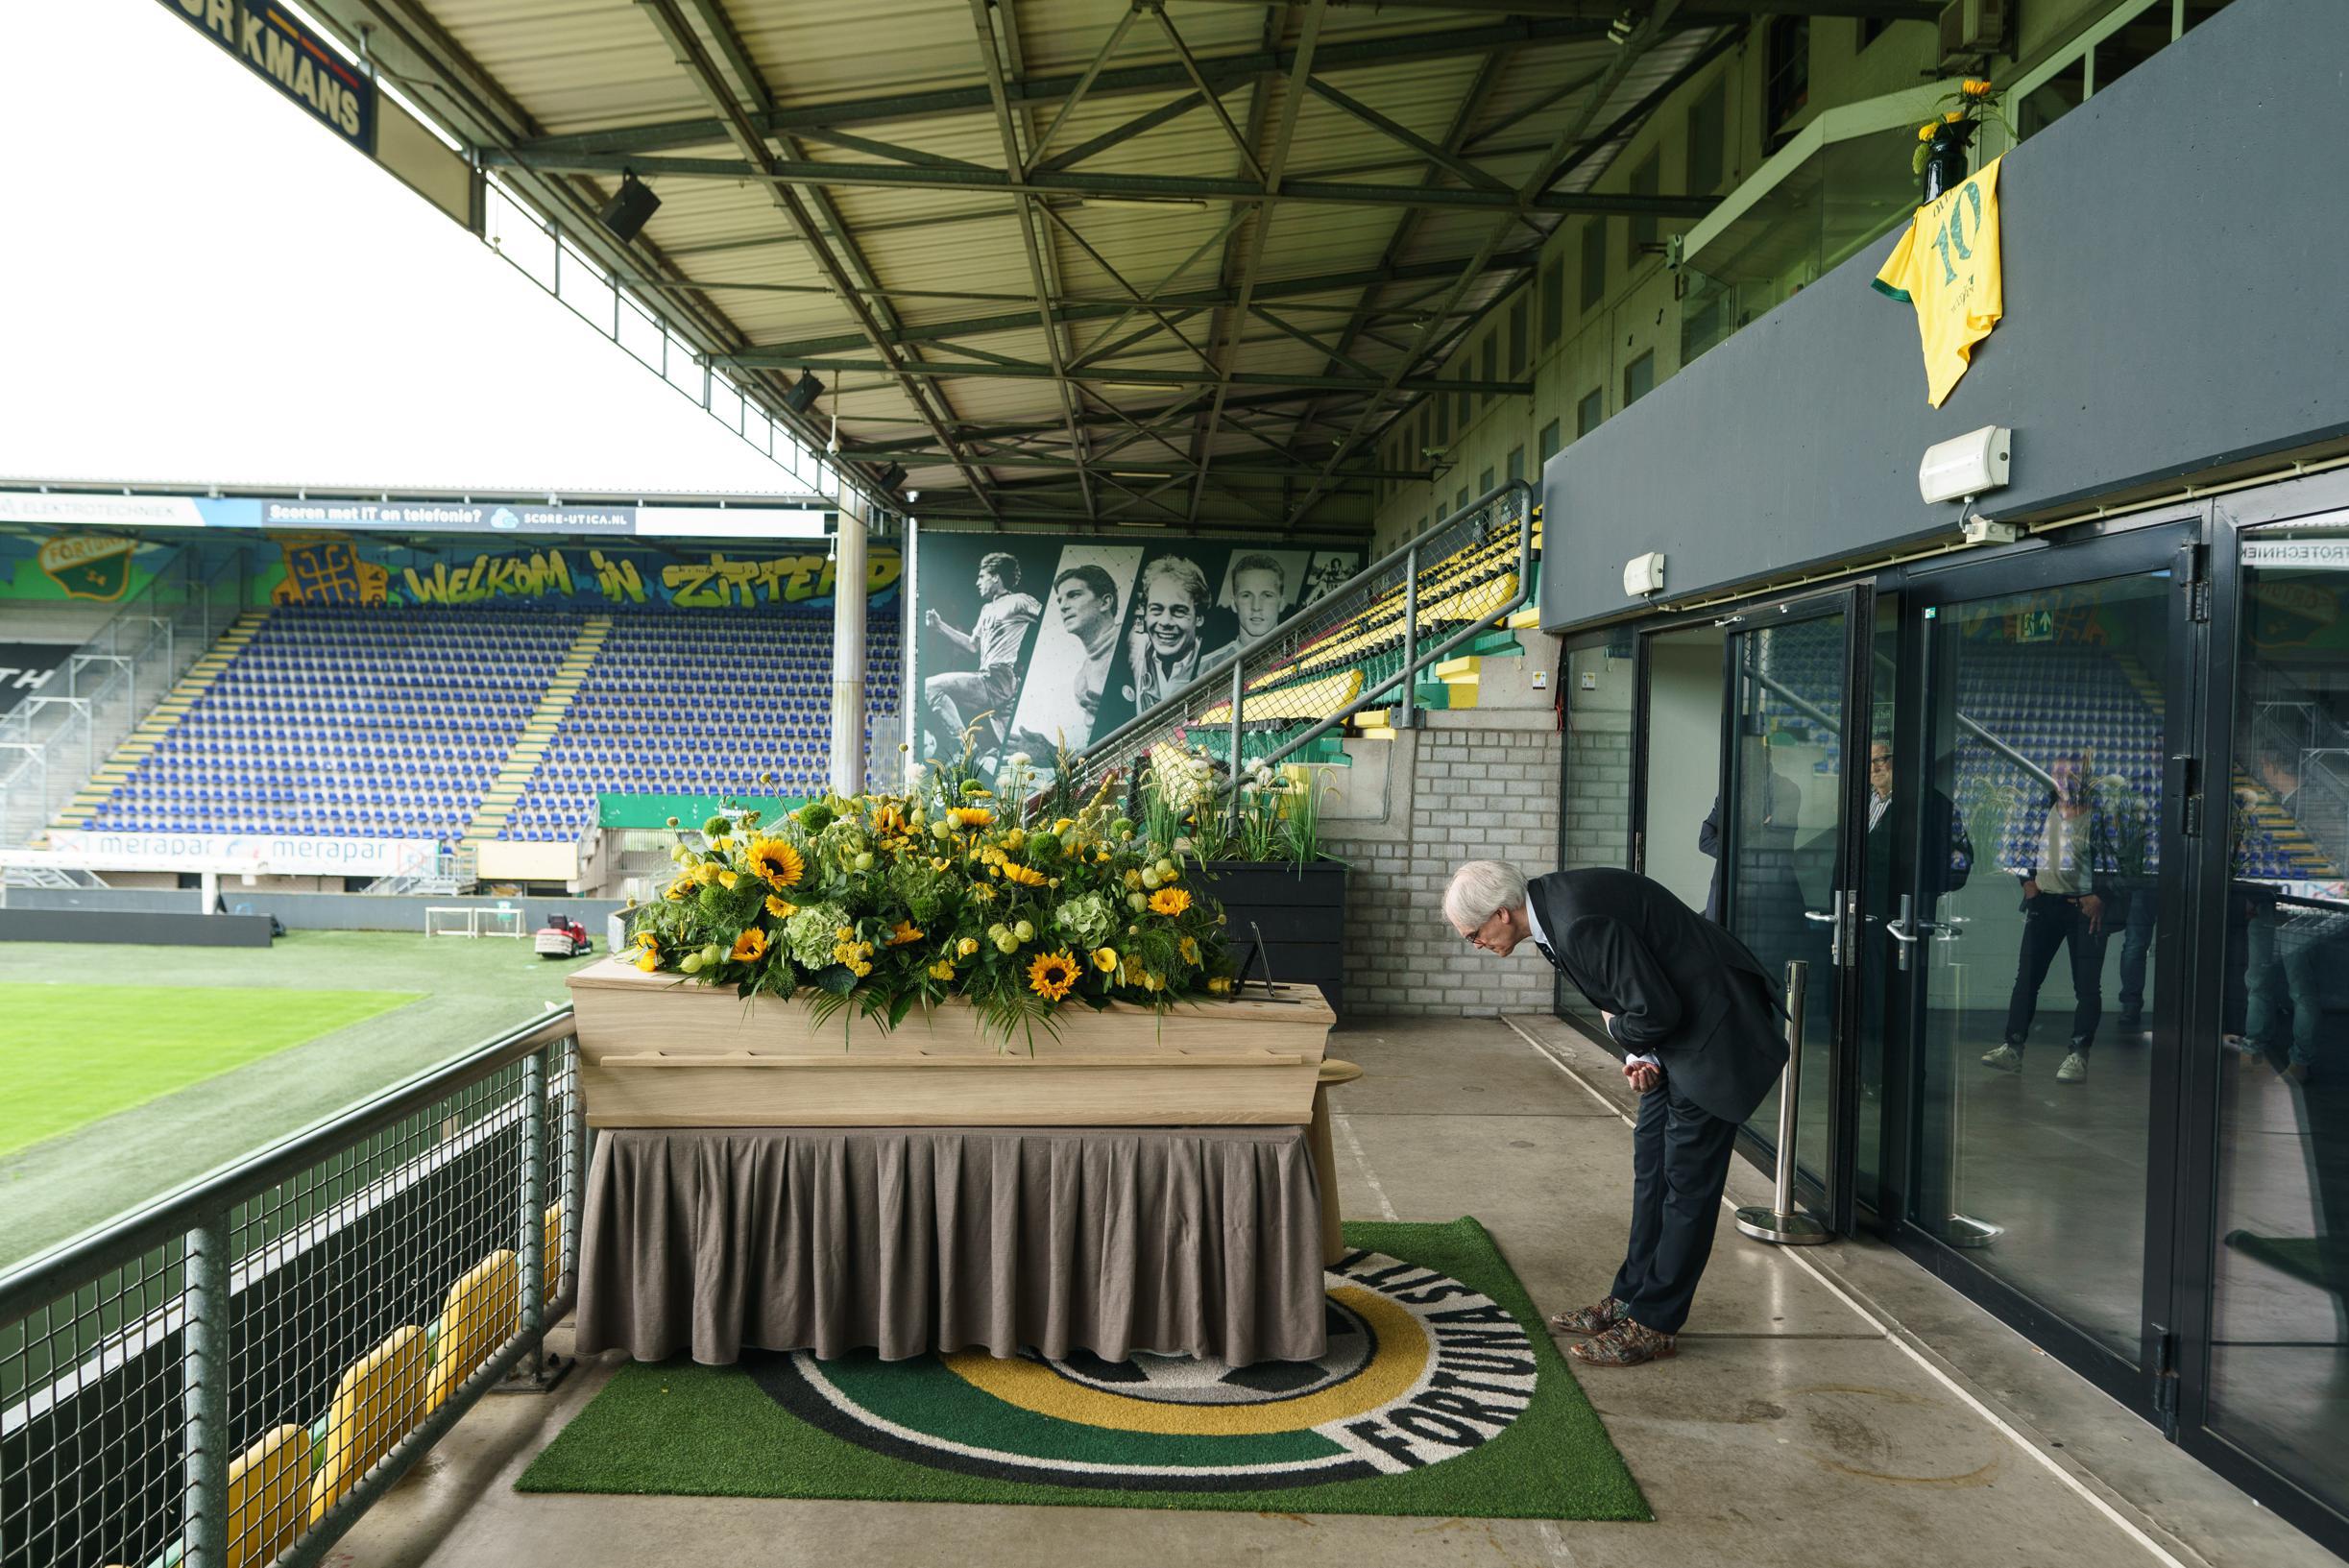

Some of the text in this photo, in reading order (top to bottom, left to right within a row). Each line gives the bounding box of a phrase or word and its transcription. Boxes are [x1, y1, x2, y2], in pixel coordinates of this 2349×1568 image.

[1930, 181, 1981, 288] 10
[23, 502, 175, 518] ELEKTROTECHNIEK
[270, 504, 483, 523] Scoren met IT en telefonie?
[523, 513, 627, 525] SCORE-UTICA.NL
[101, 836, 214, 856] merapar
[273, 840, 387, 862] merapar
[1344, 1305, 1537, 1469] FORTUNA
